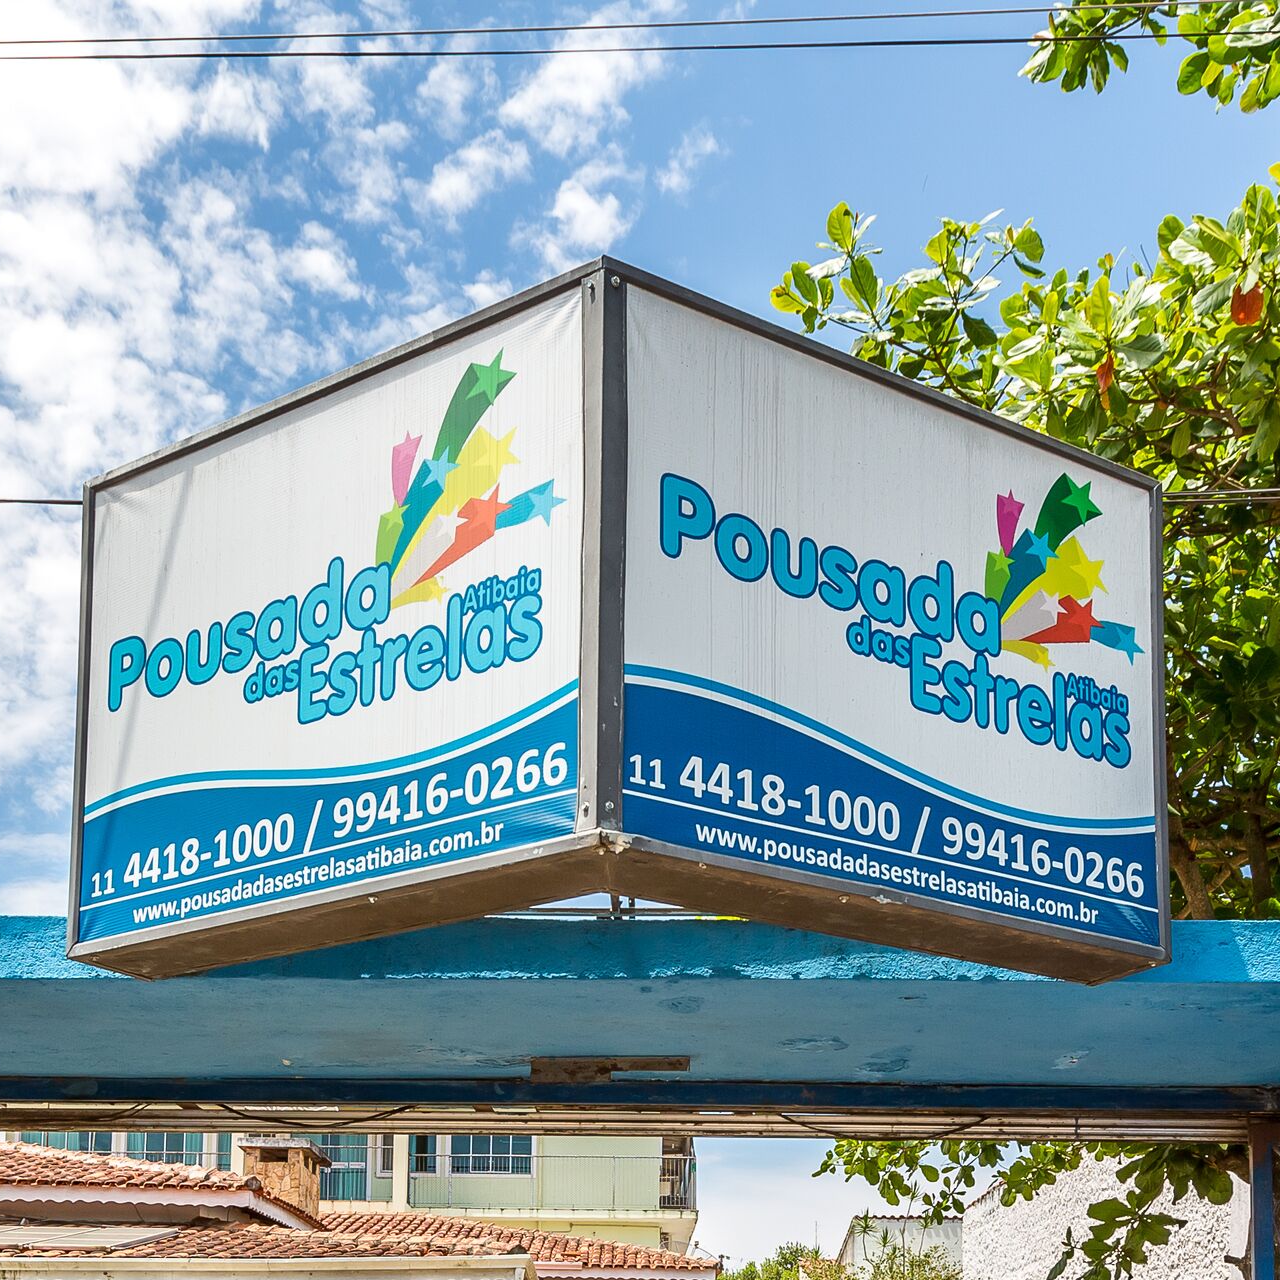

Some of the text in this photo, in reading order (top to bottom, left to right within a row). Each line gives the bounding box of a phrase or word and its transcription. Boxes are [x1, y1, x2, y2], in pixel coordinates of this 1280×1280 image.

[463, 565, 541, 615] Atibaia
[660, 472, 1002, 656] Pousada
[108, 556, 391, 713] Pousada
[243, 593, 543, 725] das Estrelas
[846, 615, 1131, 768] das Estrelas
[1066, 672, 1128, 714] Atibaia
[91, 869, 115, 898] 11
[123, 813, 295, 888] 4418-1000
[333, 742, 568, 839] 99416-0266
[132, 821, 505, 924] www.pousadadasestrelasatibaia.com.br
[629, 754, 666, 790] 11
[679, 755, 901, 842] 4418-1000
[941, 816, 1145, 898] 99416-0266
[695, 824, 1099, 924] www.pousadadasestrelasatibaia.com.br
